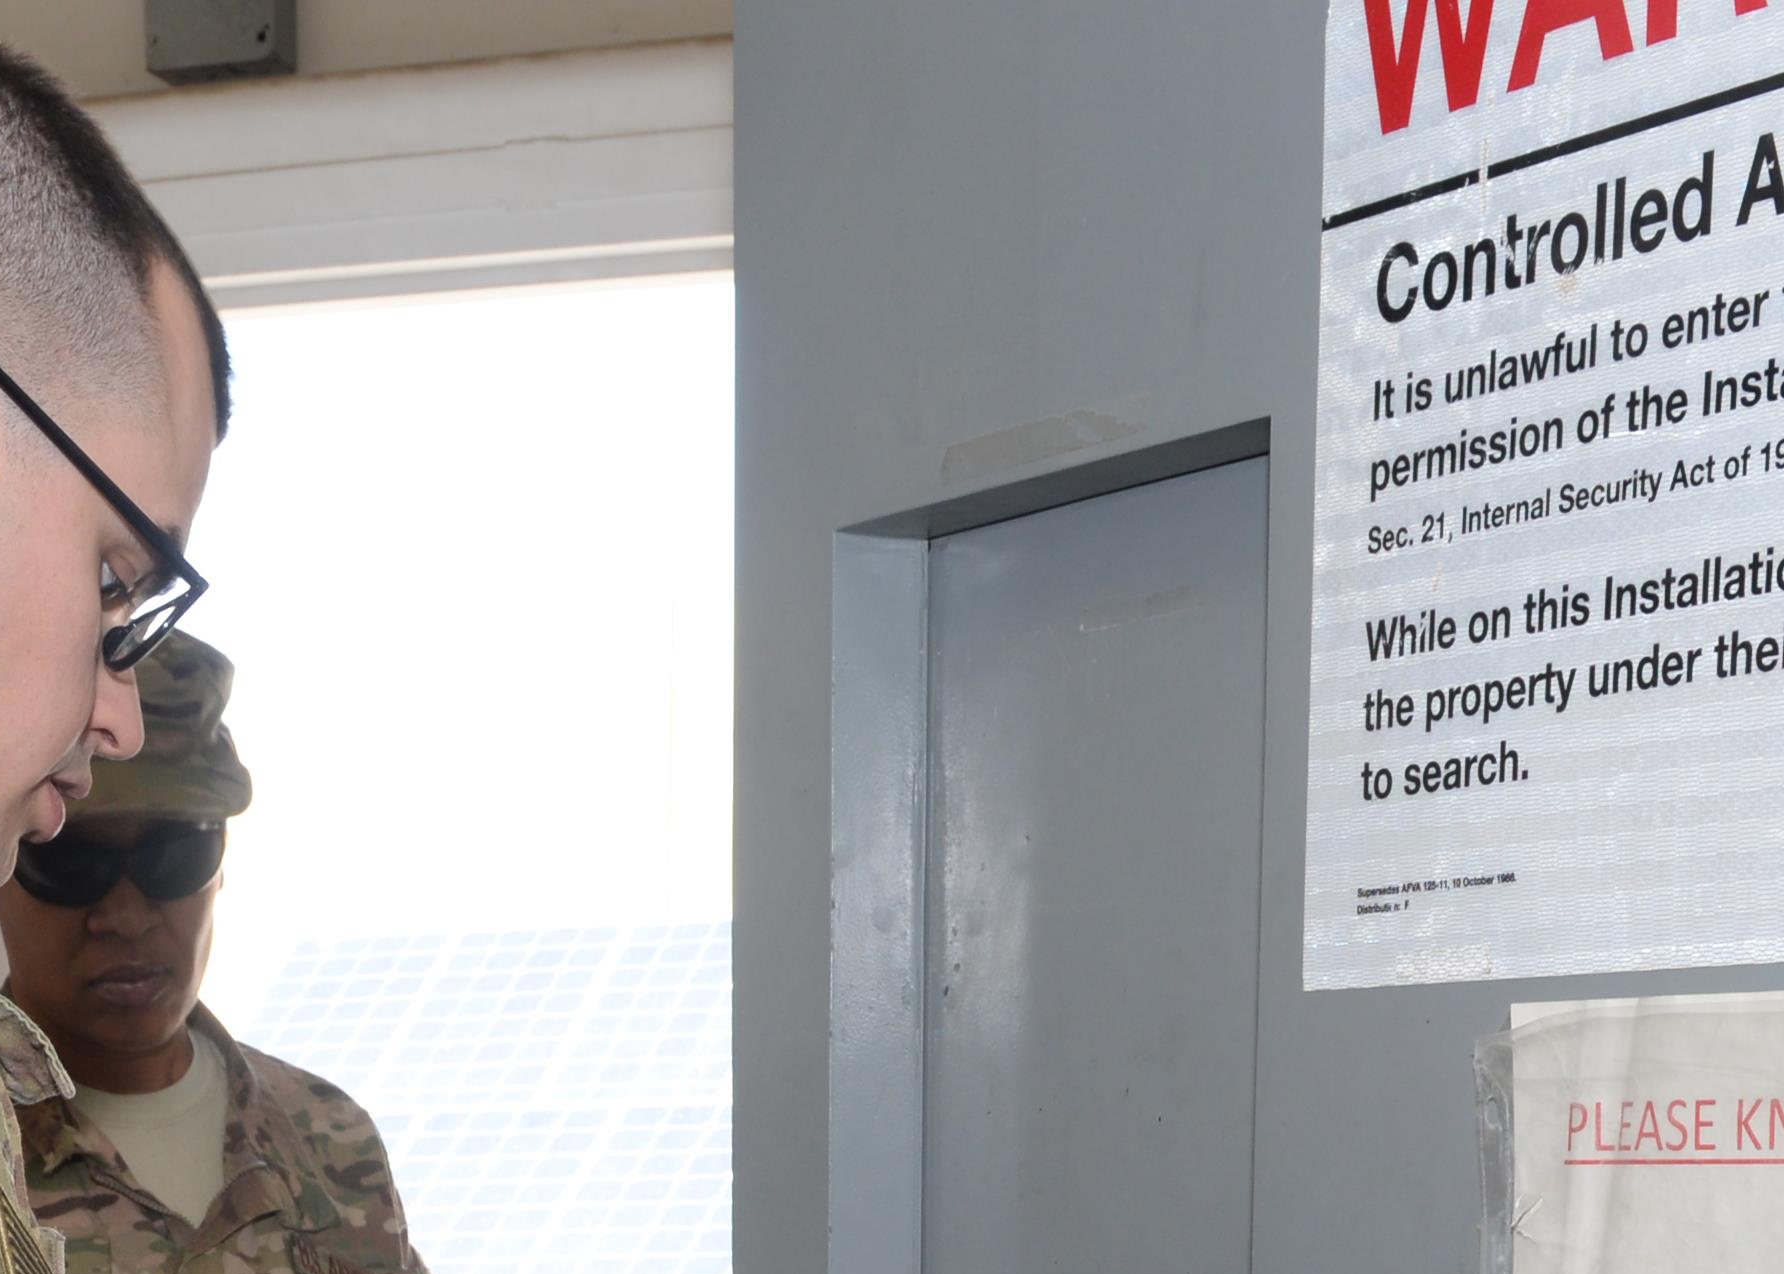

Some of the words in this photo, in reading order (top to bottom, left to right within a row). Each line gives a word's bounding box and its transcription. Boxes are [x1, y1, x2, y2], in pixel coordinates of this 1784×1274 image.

[1377, 151, 1714, 323] Controlled
[1375, 380, 1394, 420] It
[1407, 379, 1432, 413] is
[1446, 324, 1596, 403] unlawful
[1611, 320, 1647, 361] to
[1663, 291, 1769, 348] enter
[1371, 419, 1562, 502] permission
[1577, 394, 1615, 443] of
[1626, 386, 1687, 431] the
[1369, 526, 1412, 555] Sec.
[1422, 512, 1453, 544] 21,
[1462, 487, 1550, 536] Internal
[1558, 468, 1662, 515] Security
[1669, 456, 1716, 490] Act
[1725, 446, 1751, 481] of
[1367, 610, 1456, 661] While
[1469, 607, 1510, 643] on
[1524, 585, 1589, 633] this
[1364, 690, 1413, 731] the
[1426, 664, 1575, 732] property
[1589, 644, 1701, 697] under
[1361, 763, 1392, 800] to
[1404, 741, 1527, 795] search.
[1357, 886, 1399, 898] Supersedes
[1463, 875, 1494, 887] October
[1569, 1099, 1717, 1152] PLEASE
